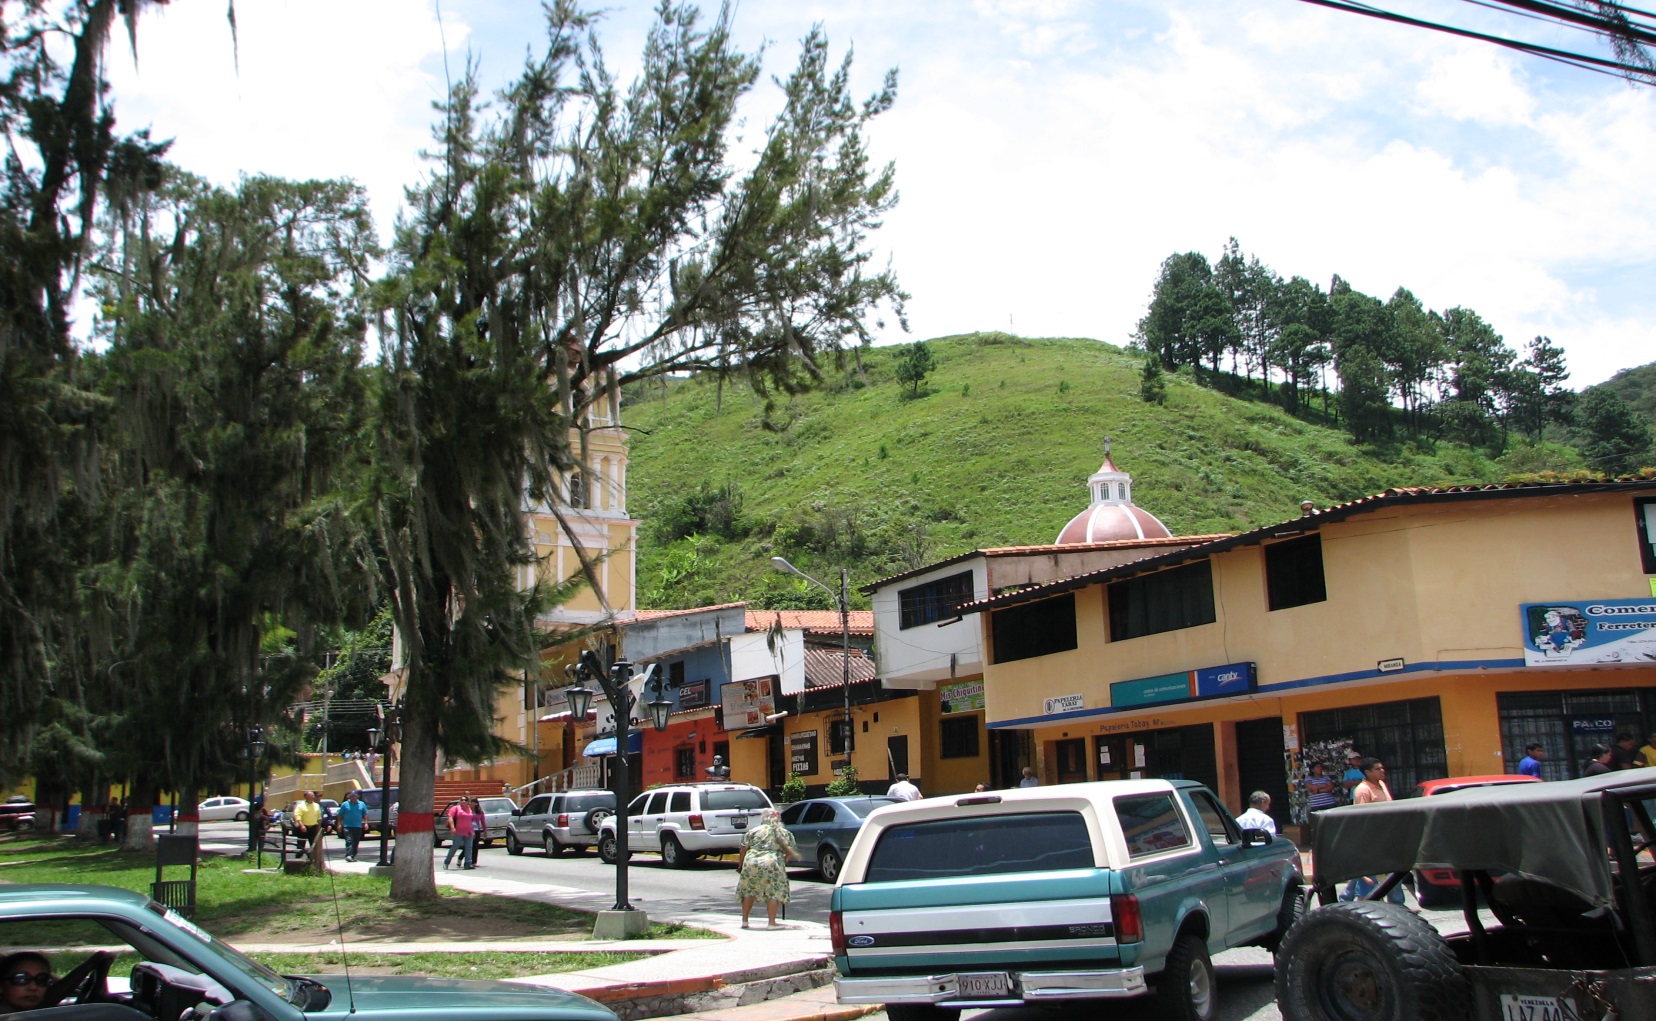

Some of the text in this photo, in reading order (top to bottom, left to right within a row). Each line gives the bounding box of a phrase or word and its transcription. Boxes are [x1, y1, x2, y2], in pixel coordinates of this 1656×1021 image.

[1053, 695, 1083, 703] PAPELERIA
[962, 979, 1003, 991] 910 XJJ
